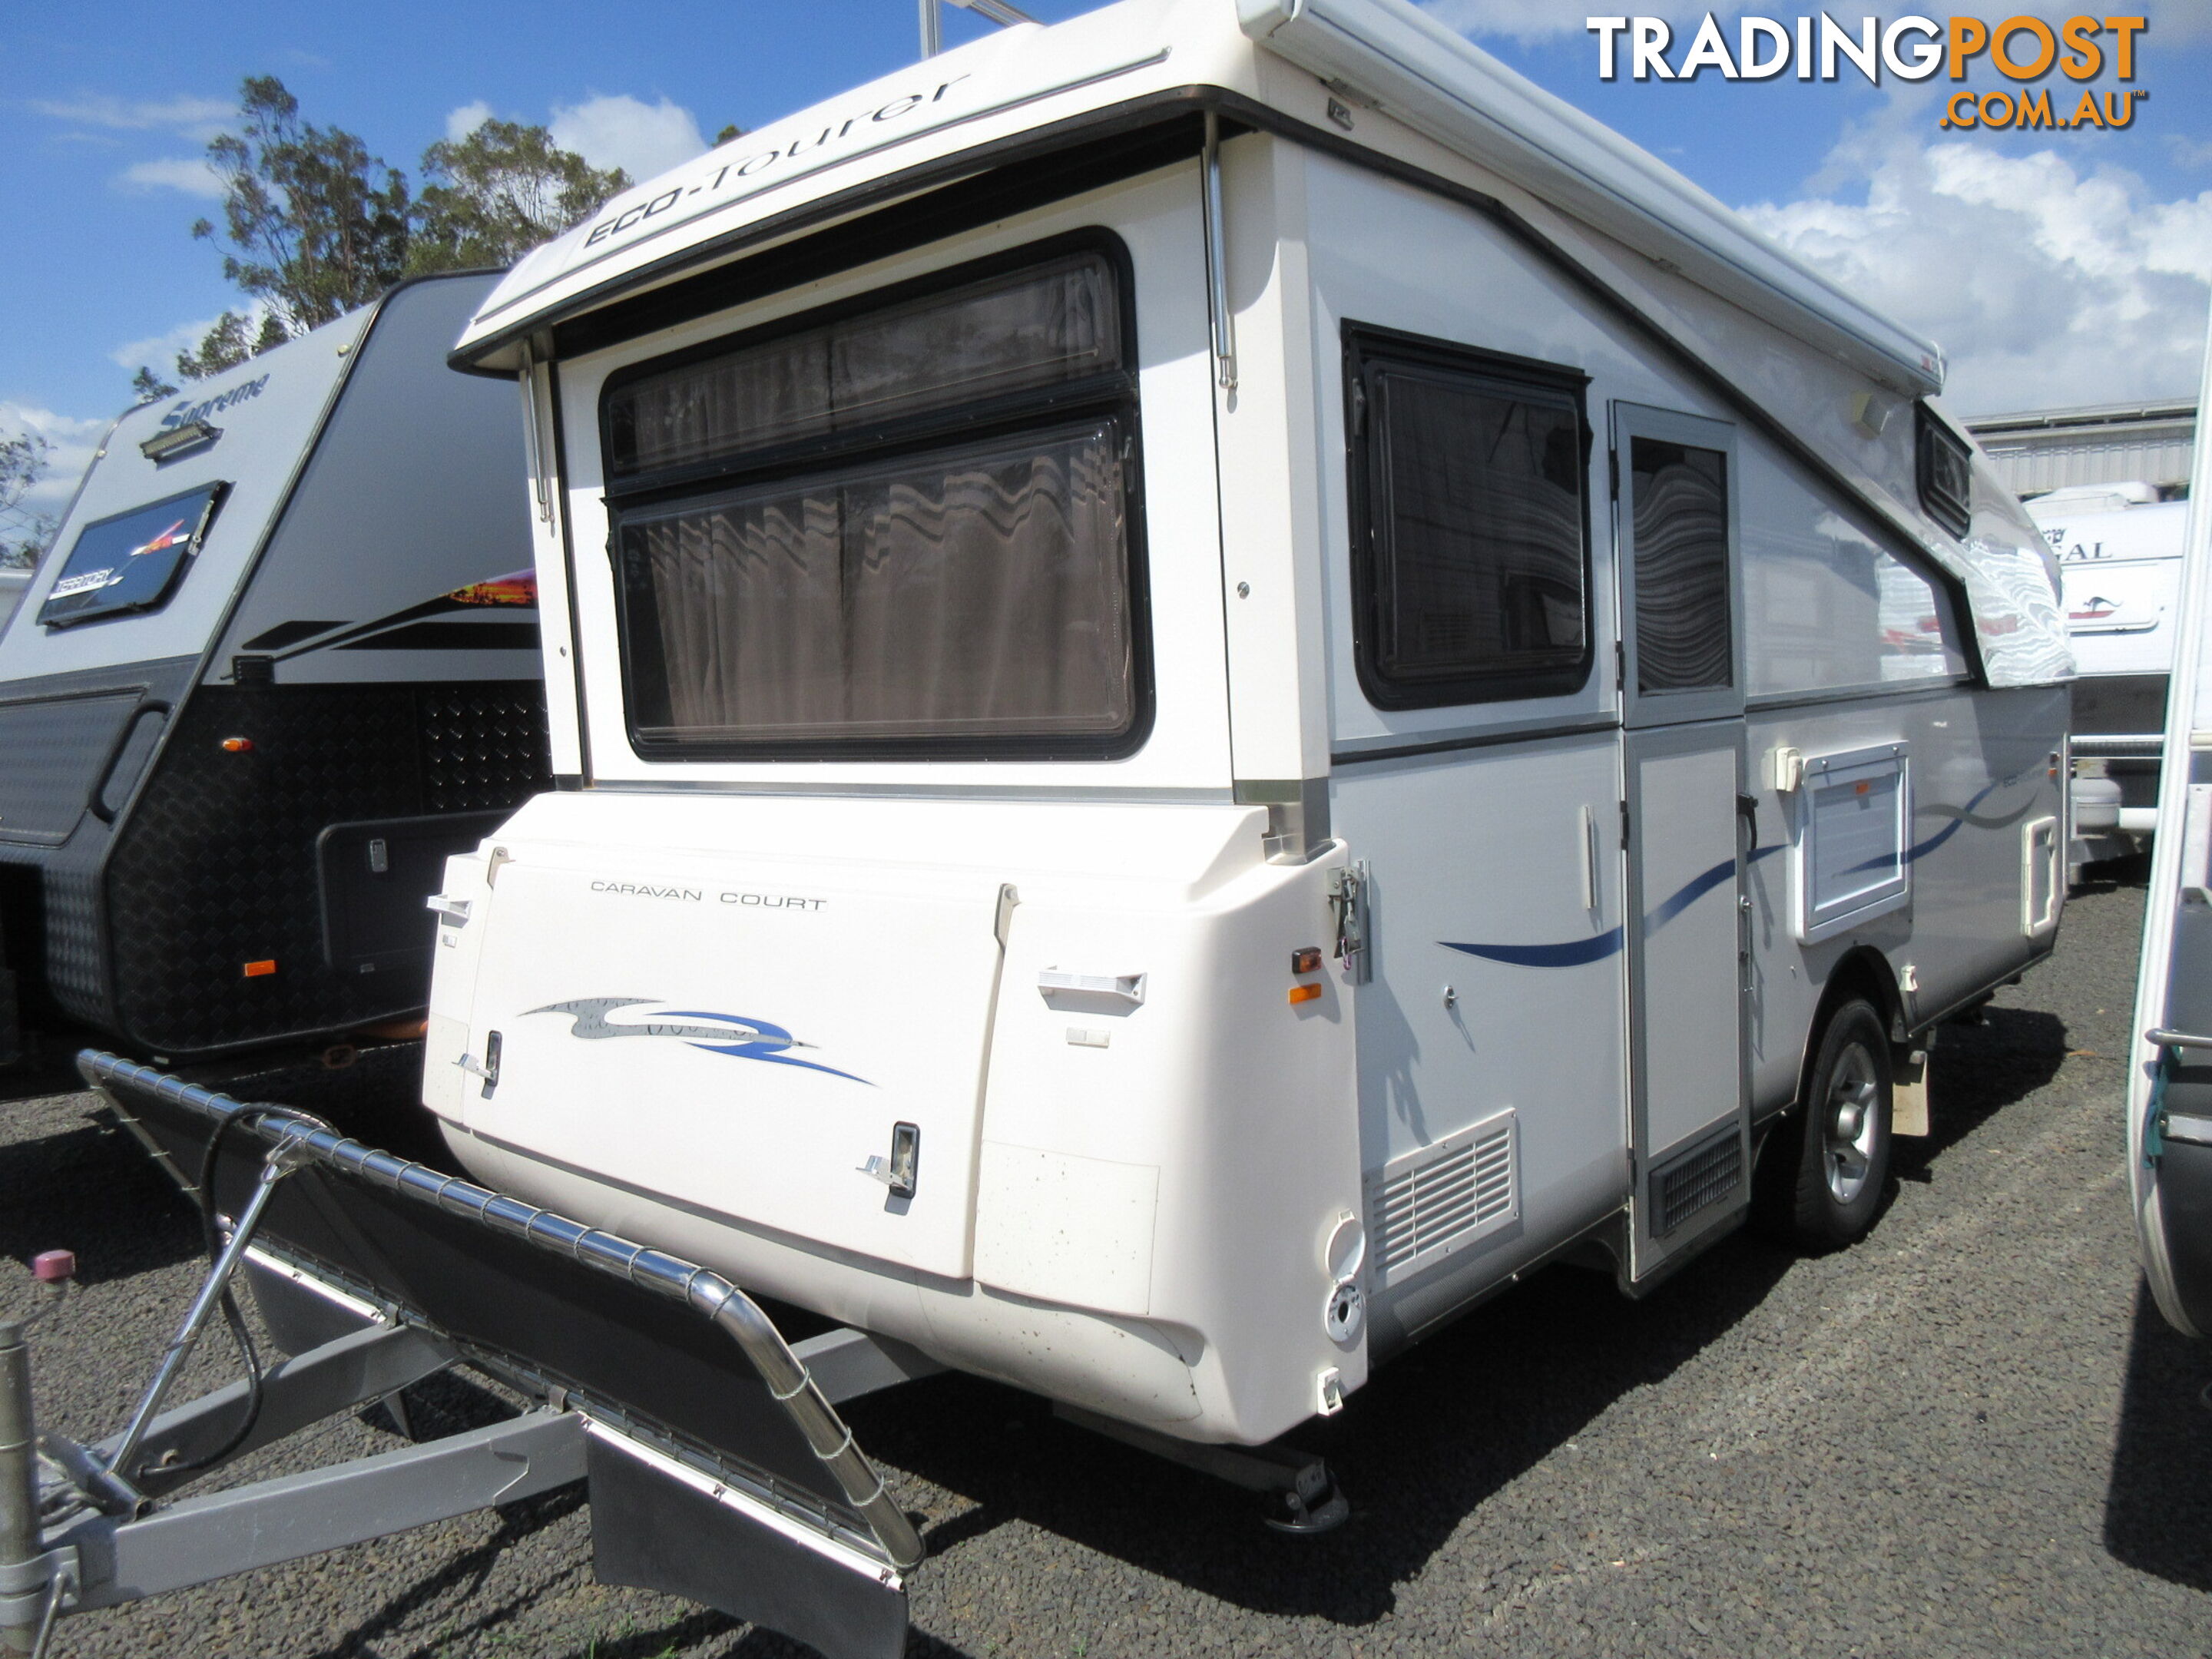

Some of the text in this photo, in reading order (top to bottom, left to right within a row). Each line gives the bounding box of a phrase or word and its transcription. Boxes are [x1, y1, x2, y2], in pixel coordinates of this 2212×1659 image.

[161, 373, 270, 427] Supreme
[591, 881, 827, 911] CARAVAN COURT
